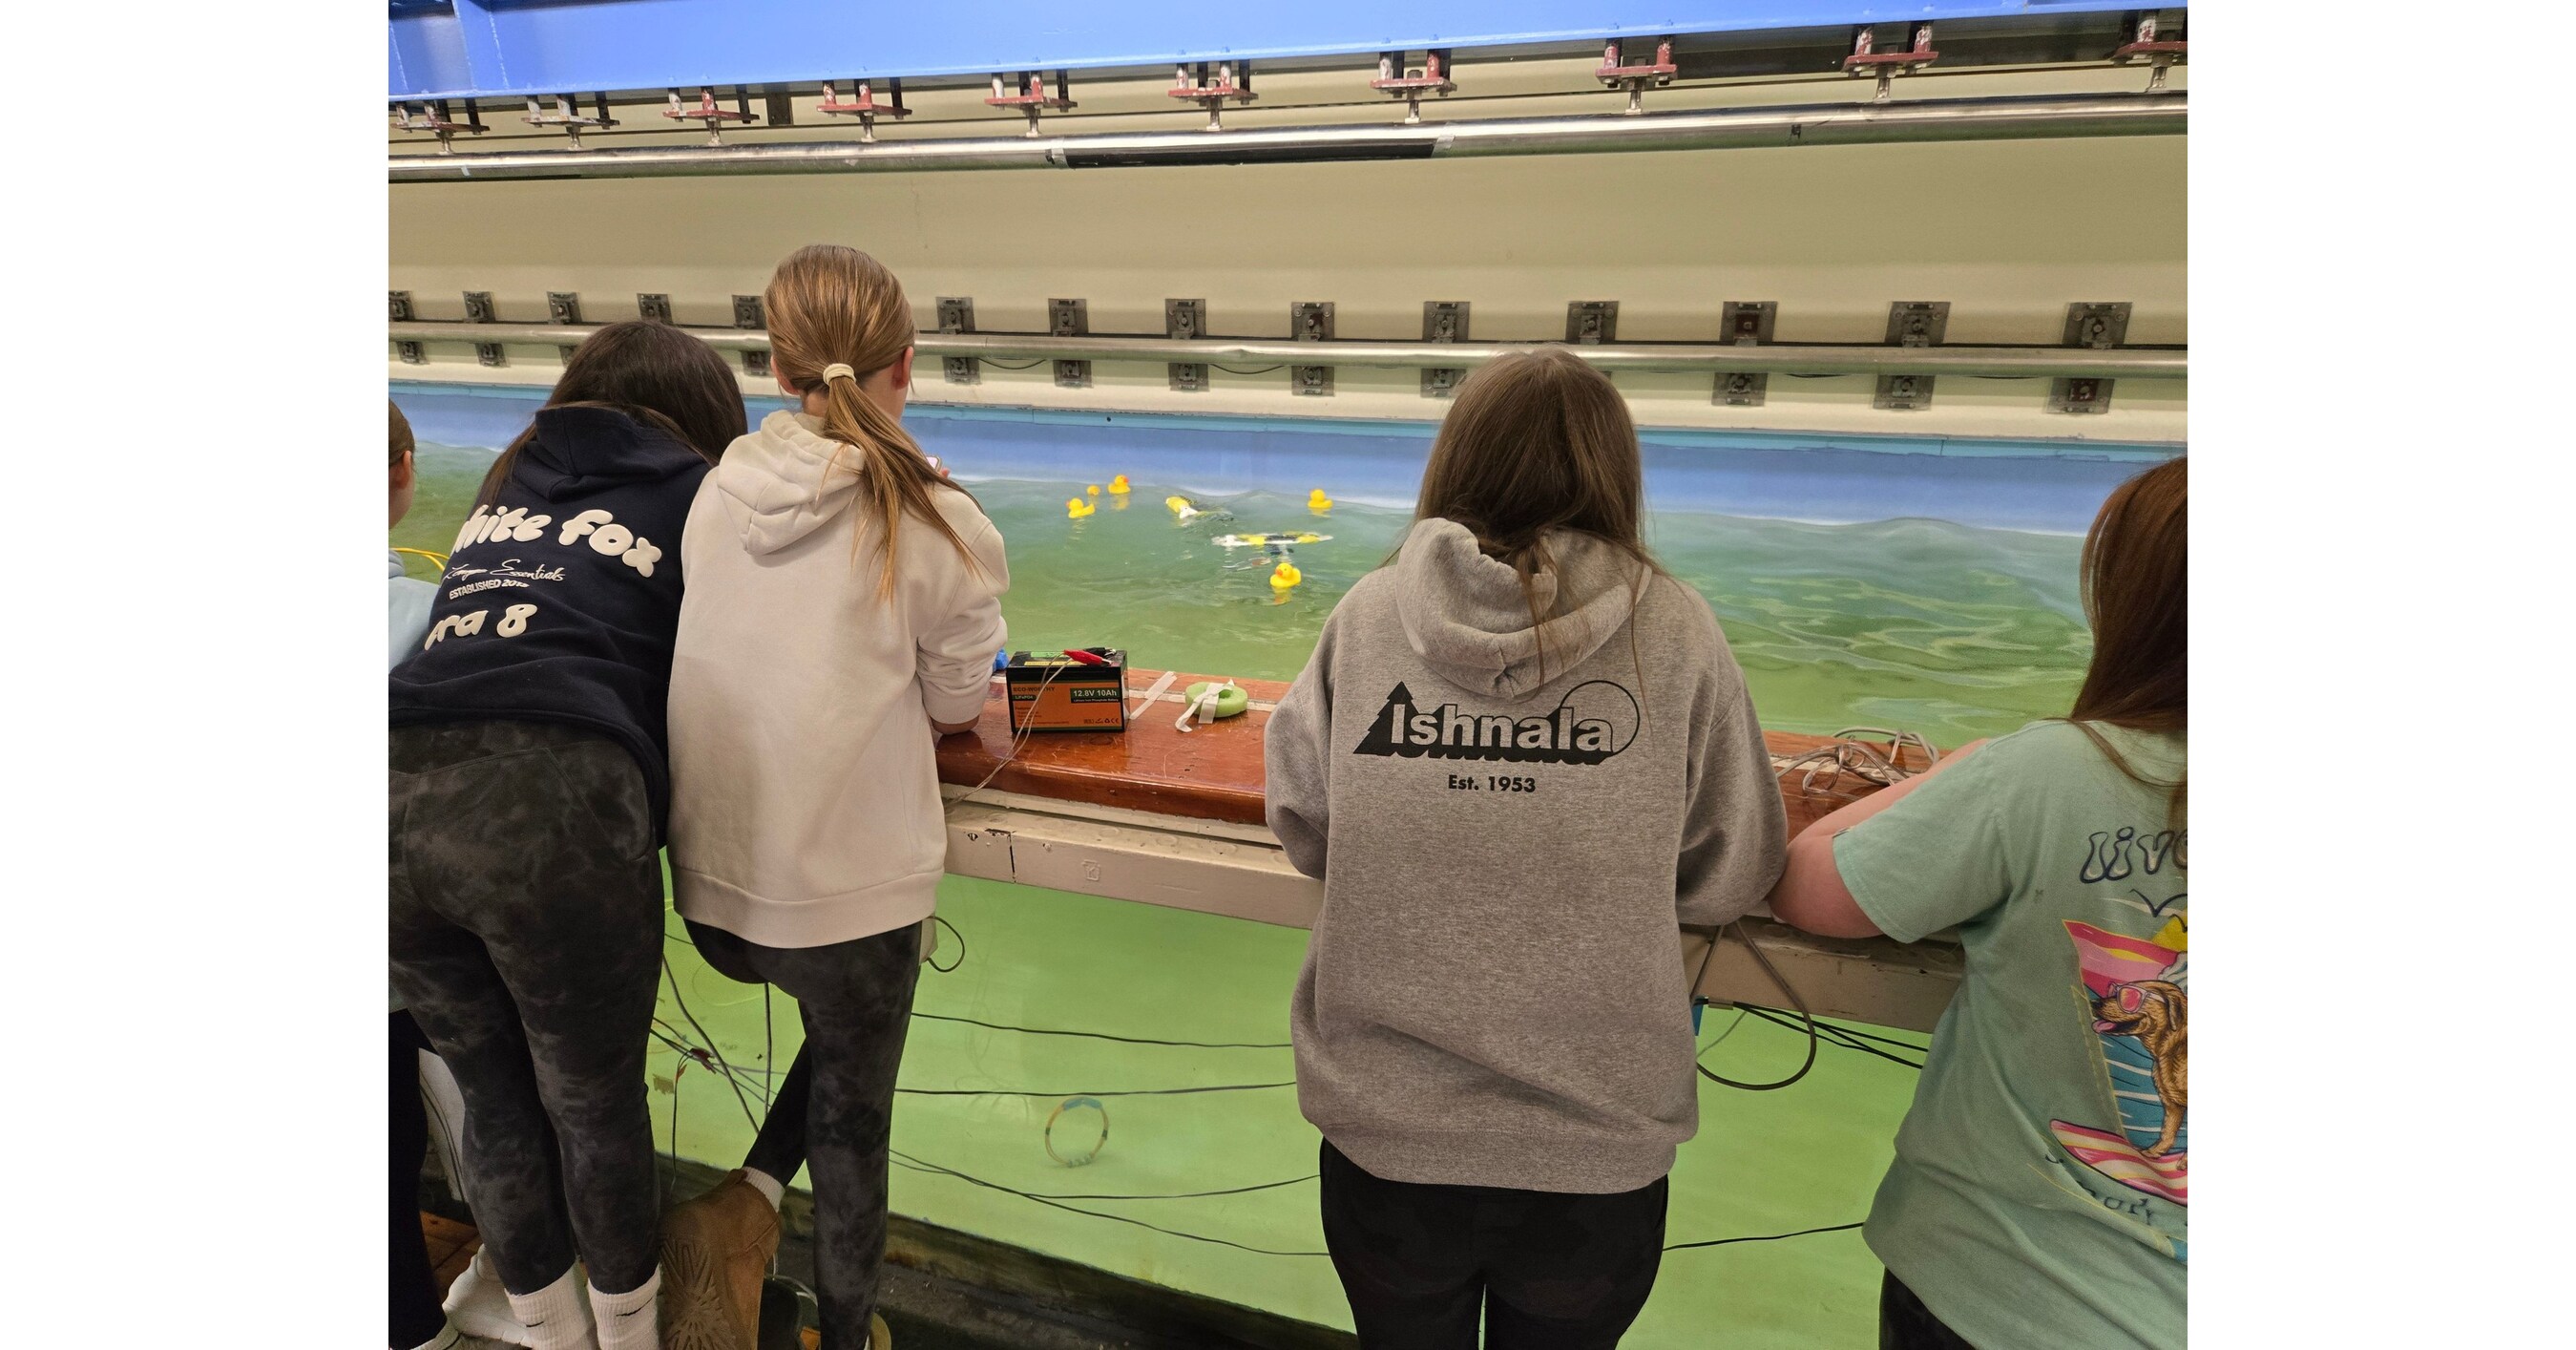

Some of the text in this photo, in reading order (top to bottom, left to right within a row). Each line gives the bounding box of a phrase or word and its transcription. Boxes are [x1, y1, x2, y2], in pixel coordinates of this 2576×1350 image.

[449, 579, 501, 601] ESTABLISHED
[496, 603, 537, 638] 8
[1390, 702, 1618, 755] Ishnala
[1448, 774, 1536, 793] Est. 1953
